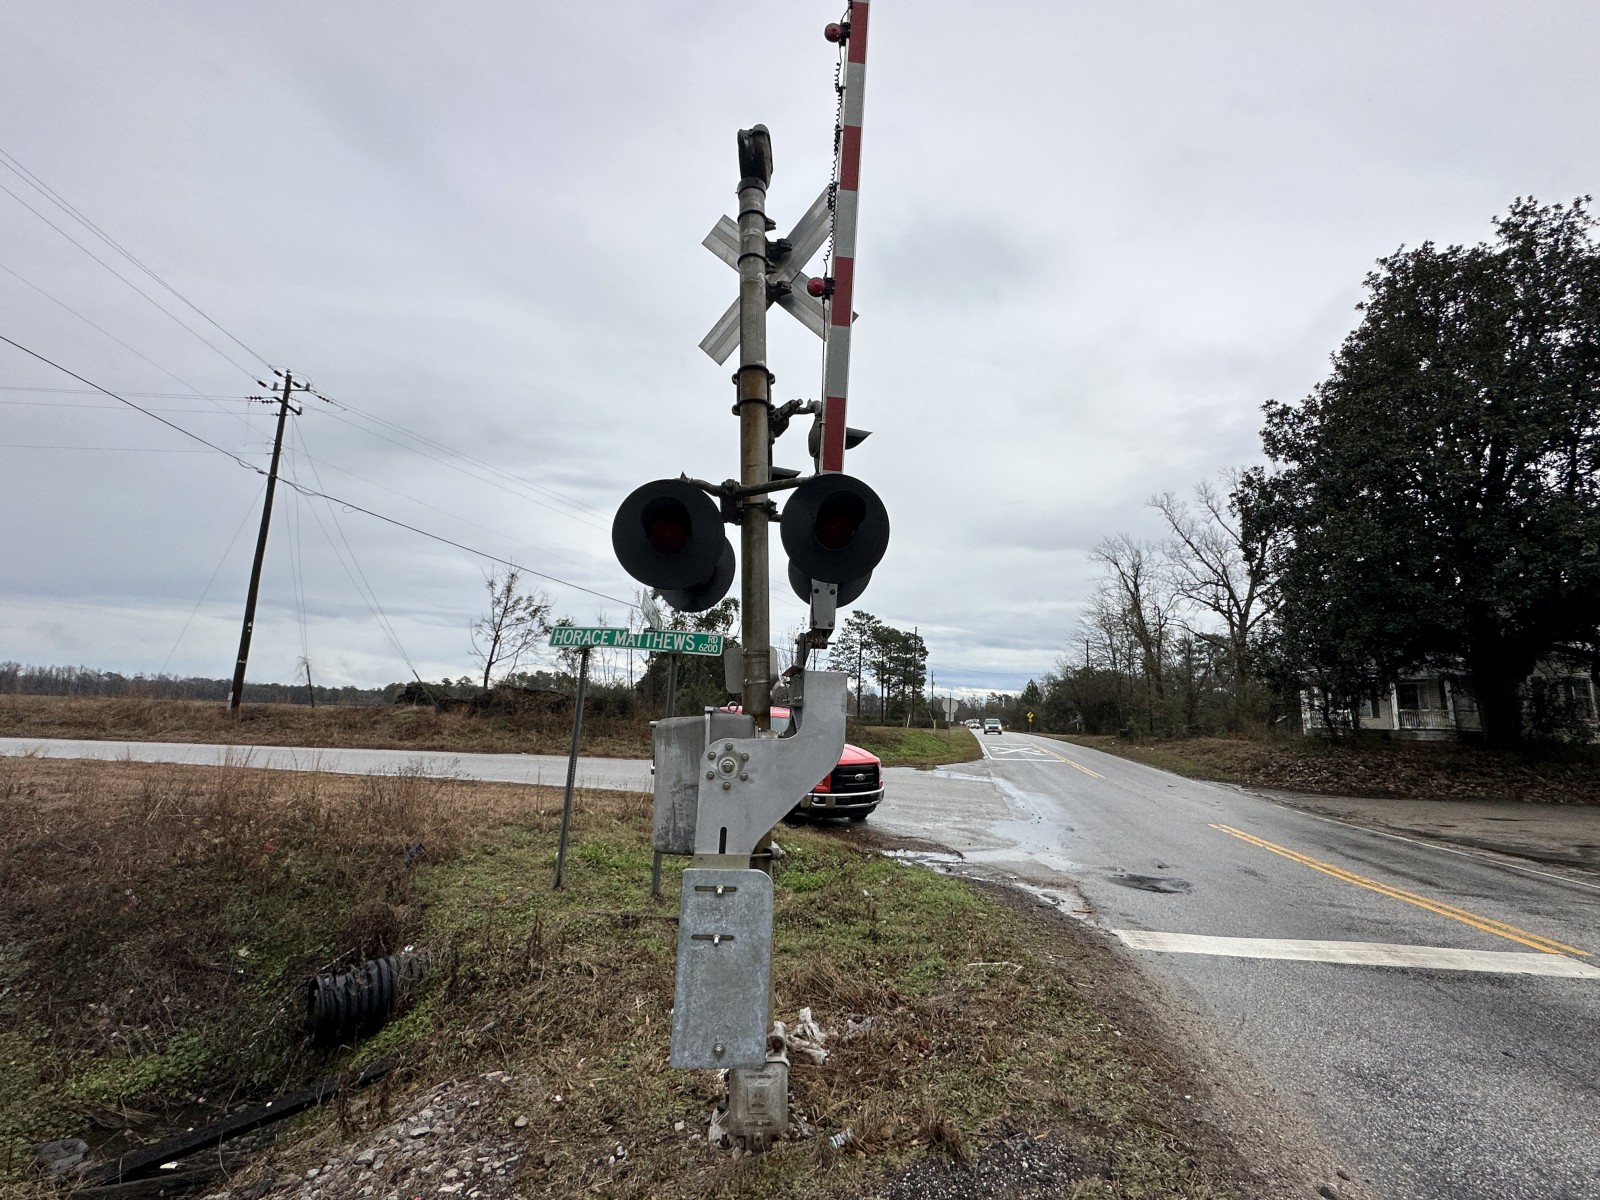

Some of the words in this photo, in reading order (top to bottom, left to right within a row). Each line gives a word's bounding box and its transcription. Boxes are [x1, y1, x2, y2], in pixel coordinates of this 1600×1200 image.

[553, 629, 611, 646] HORACE
[707, 635, 718, 644] RD
[698, 644, 718, 653] 6200
